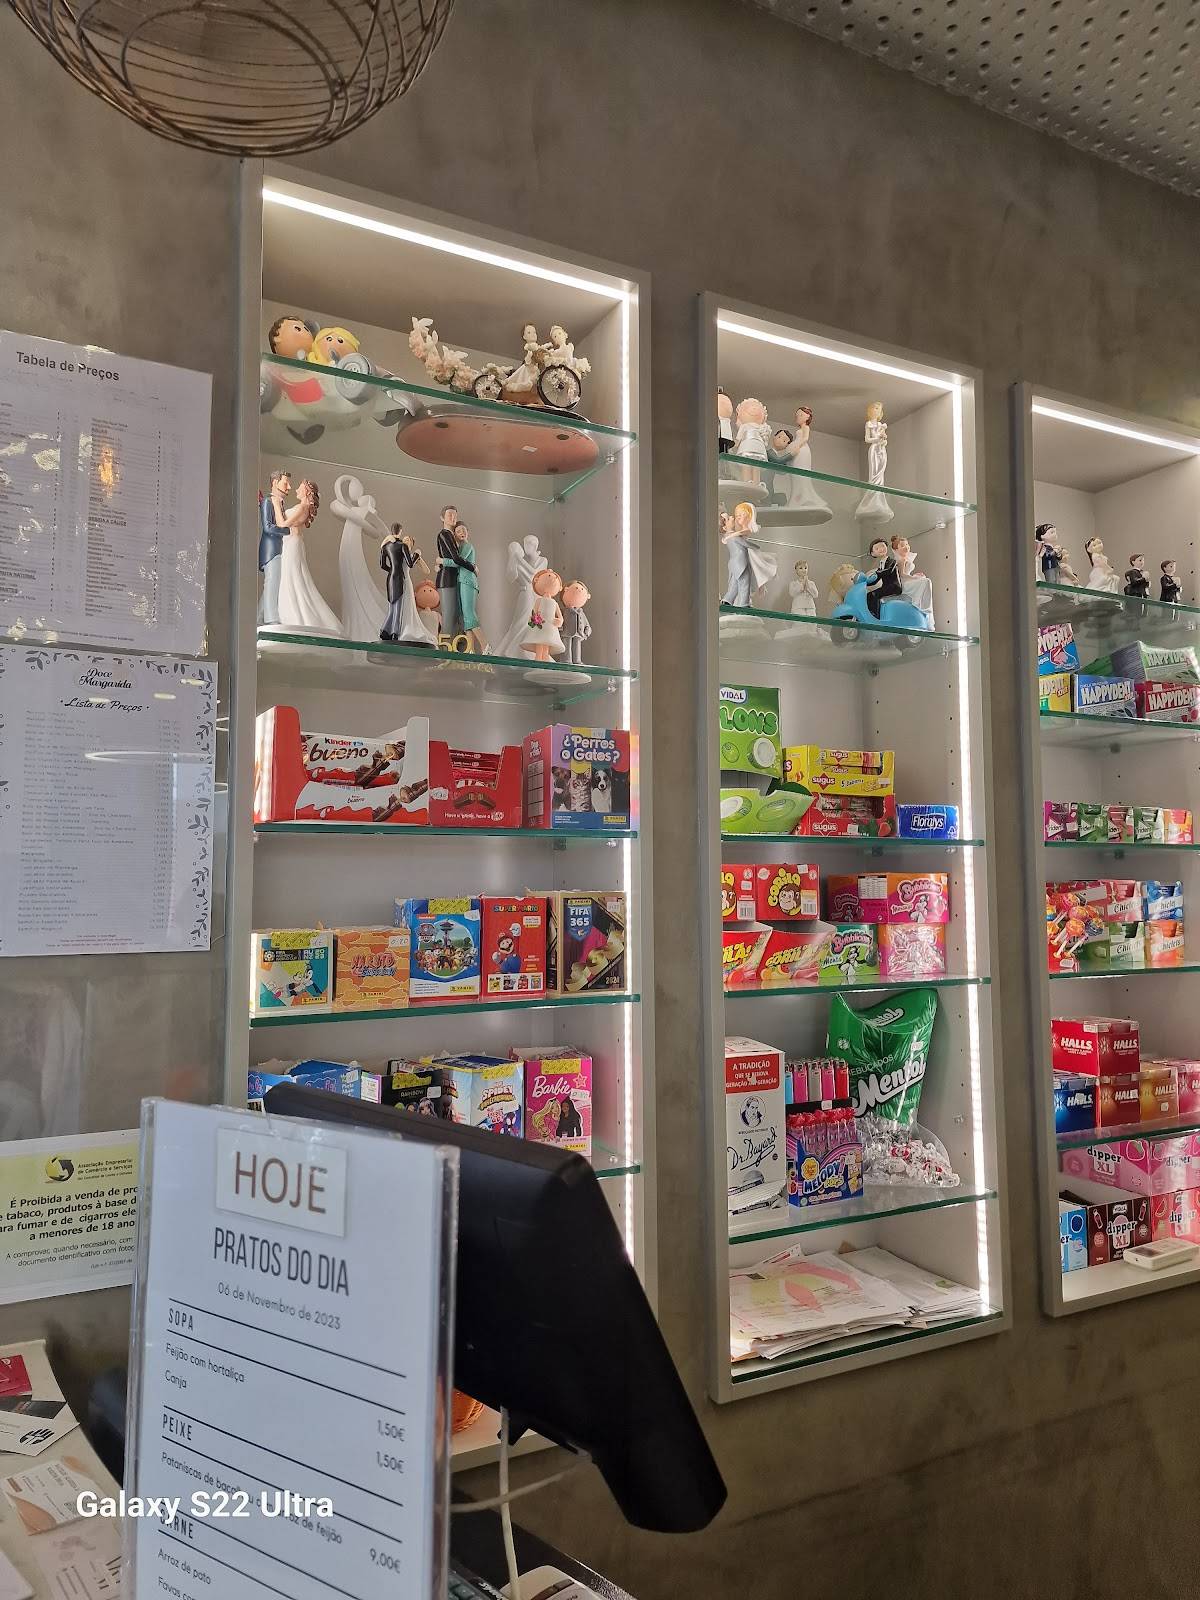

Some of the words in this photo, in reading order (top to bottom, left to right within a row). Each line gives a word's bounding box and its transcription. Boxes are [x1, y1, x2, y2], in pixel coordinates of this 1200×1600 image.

[16, 351, 56, 370] Tabela
[60, 360, 75, 373] de
[77, 363, 120, 381] Preços
[438, 633, 470, 653] 50
[79, 675, 132, 690] Margarida
[87, 668, 113, 679] Doce
[720, 690, 744, 700] VIDAL
[1081, 680, 1131, 705] HAPPYDENT
[64, 697, 94, 710] Lista
[110, 701, 143, 713] Preços
[309, 743, 369, 762] bueno
[563, 734, 615, 750] ¿Perros
[912, 814, 945, 830] Floralys
[570, 917, 590, 926] 365
[1061, 1037, 1093, 1051] HALLS
[1113, 1039, 1138, 1050] HALLS
[740, 1060, 770, 1071] TRADIÇÃO
[532, 1076, 571, 1098] Barbie
[1115, 1089, 1138, 1101] HAL
[1087, 1146, 1122, 1164] dipper
[803, 1162, 841, 1193] MELODY
[1097, 1161, 1113, 1175] XL
[234, 1151, 328, 1215] HOJE
[10, 1197, 17, 1208] É
[20, 1194, 62, 1207] Proibida
[65, 1194, 71, 1202] a
[75, 1189, 105, 1200] venda
[108, 1188, 120, 1196] de
[6, 1210, 44, 1221] tabaco,
[47, 1202, 93, 1216] produtos
[95, 1200, 102, 1209] à
[105, 1197, 128, 1208] base
[17, 1220, 48, 1231] fumar
[60, 1216, 73, 1225] de
[79, 1211, 119, 1224] cigarros
[121, 1207, 137, 1216] ele
[29, 1233, 36, 1241] a
[39, 1225, 83, 1239] menores
[86, 1223, 98, 1233] de
[102, 1220, 114, 1231] 18
[117, 1219, 135, 1229] ano
[1107, 1221, 1137, 1236] dipper
[18, 1255, 56, 1267] documento
[59, 1248, 101, 1261] identificativo
[53, 1244, 78, 1255] quando
[80, 1239, 117, 1250] necessário,
[213, 1227, 283, 1277] PRATOS
[287, 1246, 312, 1286] DO
[317, 1253, 350, 1297] DIA
[217, 1281, 231, 1297] 06
[232, 1286, 246, 1302] de
[247, 1290, 296, 1317] Novembro
[298, 1306, 312, 1321] de
[314, 1311, 341, 1330] 2023
[168, 1307, 194, 1332] SOPA
[165, 1343, 189, 1365] Feijão
[190, 1353, 207, 1368] com
[208, 1357, 245, 1384] hortaliça
[164, 1369, 188, 1390] Canja
[162, 1413, 193, 1441] PEIXE
[376, 1419, 406, 1442] 1,50€
[375, 1451, 405, 1474] 1,50€
[161, 1451, 202, 1481] Pataniscas
[203, 1472, 215, 1486] de
[302, 1517, 314, 1531] de
[316, 1522, 343, 1544] feijão
[158, 1548, 179, 1568] Arroz
[181, 1560, 192, 1575] de
[193, 1569, 212, 1586] pato
[368, 1548, 402, 1574] 9,00€
[157, 1576, 181, 1599] Favas
